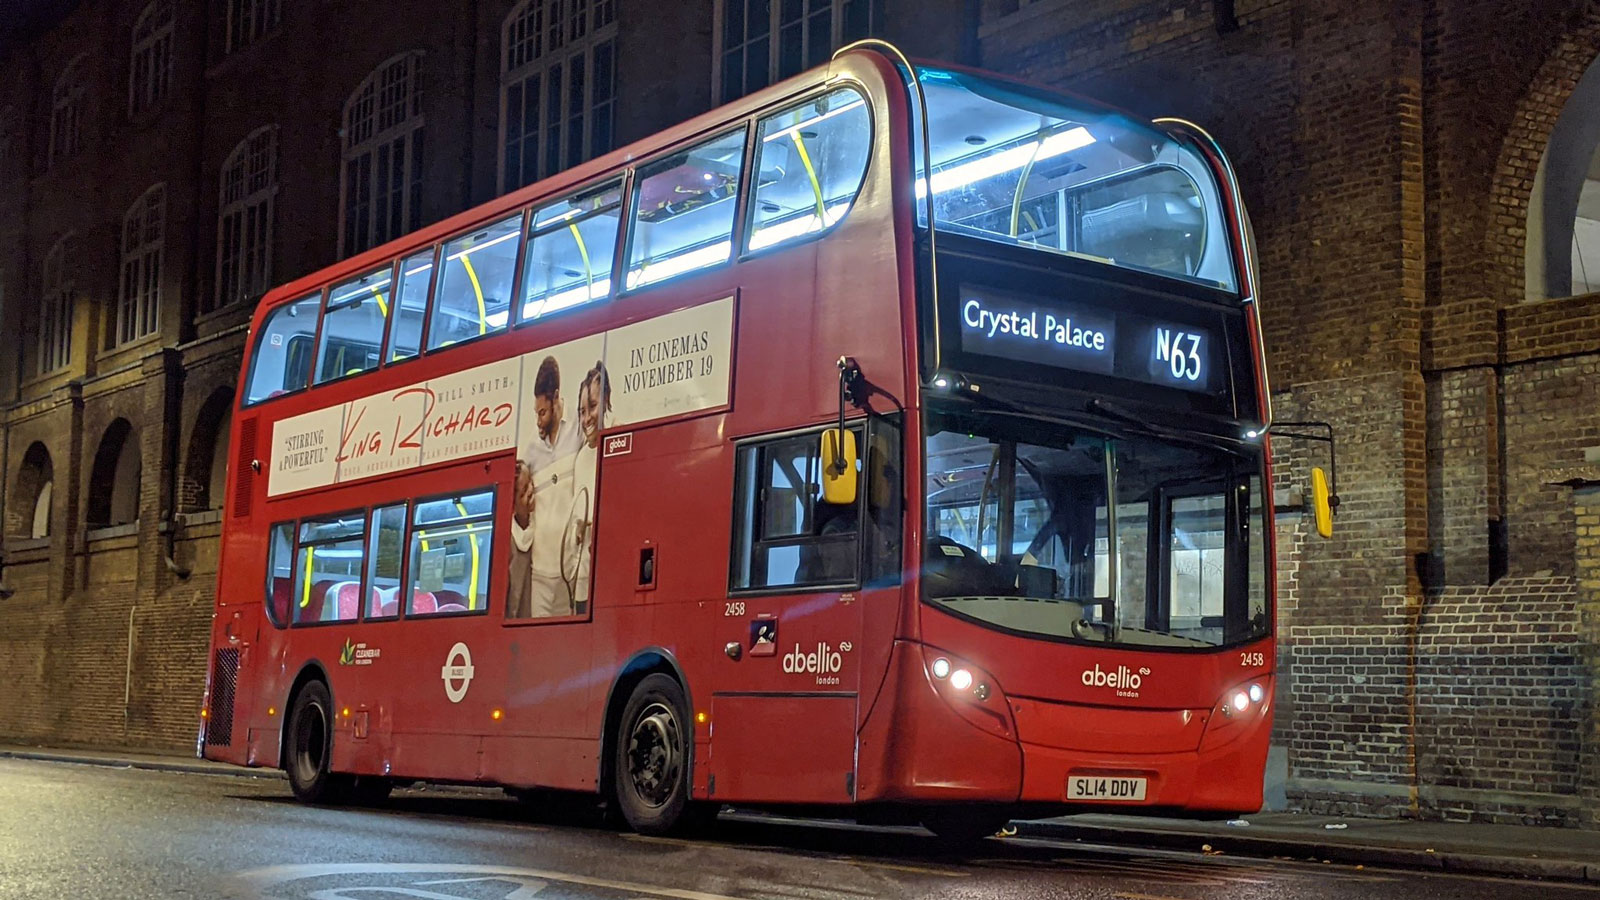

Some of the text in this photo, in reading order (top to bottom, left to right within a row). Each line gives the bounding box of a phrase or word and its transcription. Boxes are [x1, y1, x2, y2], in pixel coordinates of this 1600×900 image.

[963, 300, 1105, 351] Crystal Palace
[630, 330, 709, 369] IN CINEMAS
[1156, 327, 1201, 381] N63
[623, 354, 714, 394] NOVEMBER 19
[438, 376, 509, 403] WILL SMITH
[333, 388, 513, 485] KING RICHARD
[609, 436, 626, 453] global
[724, 602, 745, 616] 2458
[782, 642, 842, 674] abellio
[1240, 652, 1264, 667] 2458
[816, 675, 840, 685] london
[1081, 663, 1142, 689] abellio
[1116, 689, 1139, 698] london
[1076, 778, 1138, 797] SL14 DDV
